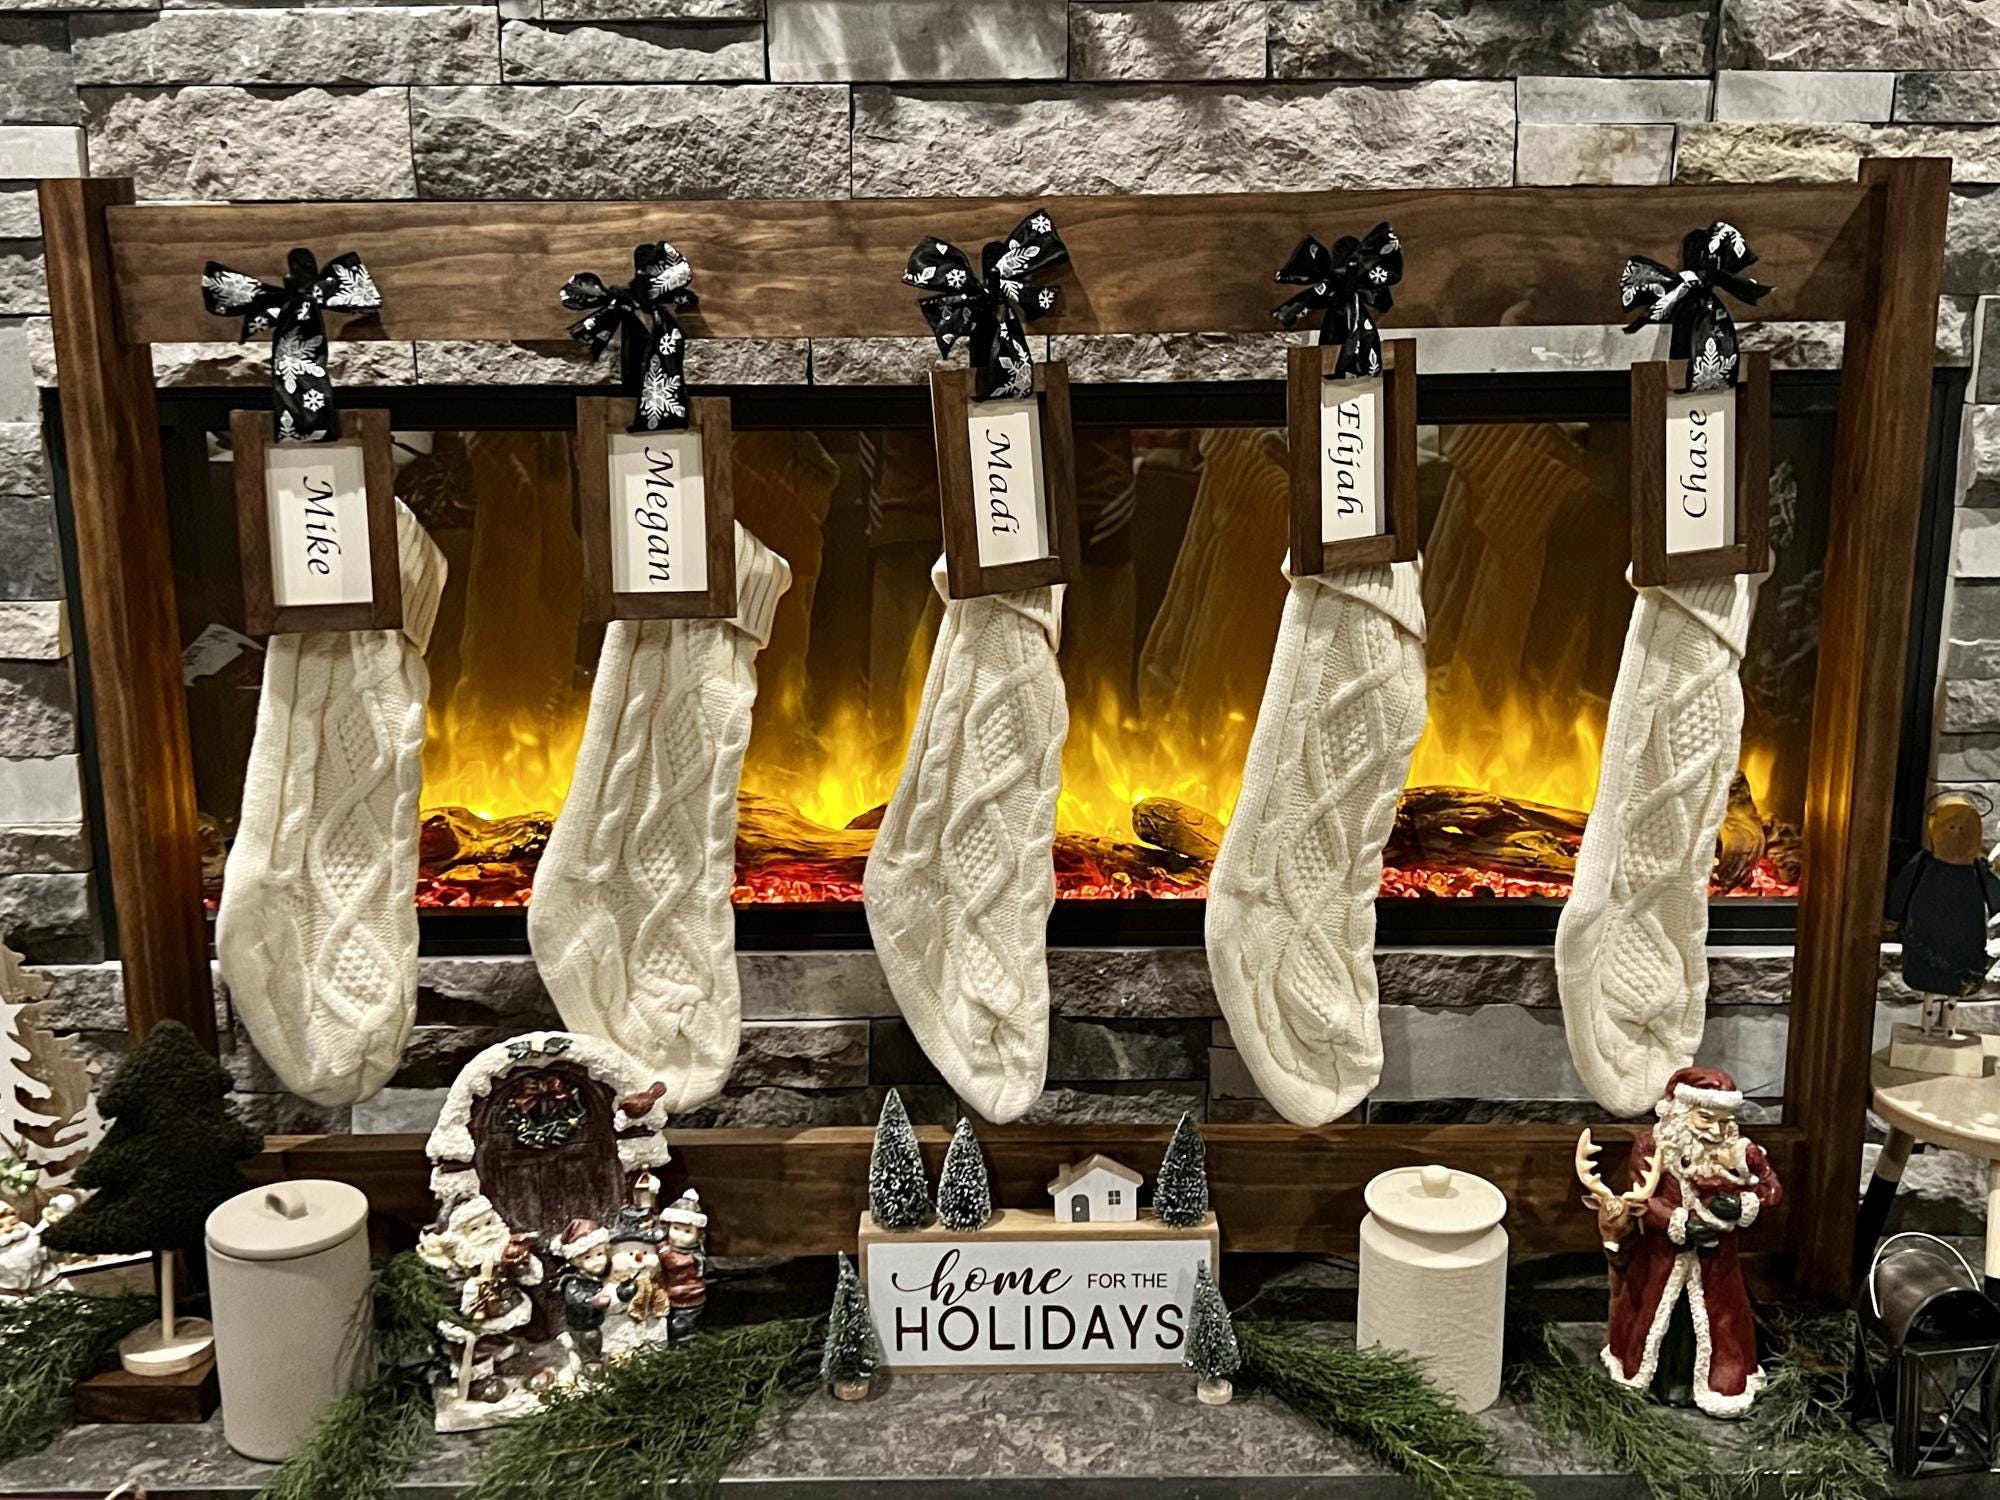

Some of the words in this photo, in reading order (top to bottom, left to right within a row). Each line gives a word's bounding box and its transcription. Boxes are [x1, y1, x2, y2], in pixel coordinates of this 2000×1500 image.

[634, 446, 675, 585] Megan
[985, 428, 1020, 537] Madi
[1327, 402, 1364, 520] Elijah
[1679, 409, 1708, 519] Chase
[303, 475, 342, 575] Mike
[891, 1248, 1073, 1306] home
[1087, 1272, 1127, 1289] FOR
[1131, 1272, 1168, 1288] THE
[895, 1303, 1185, 1351] HOLIDAYS
